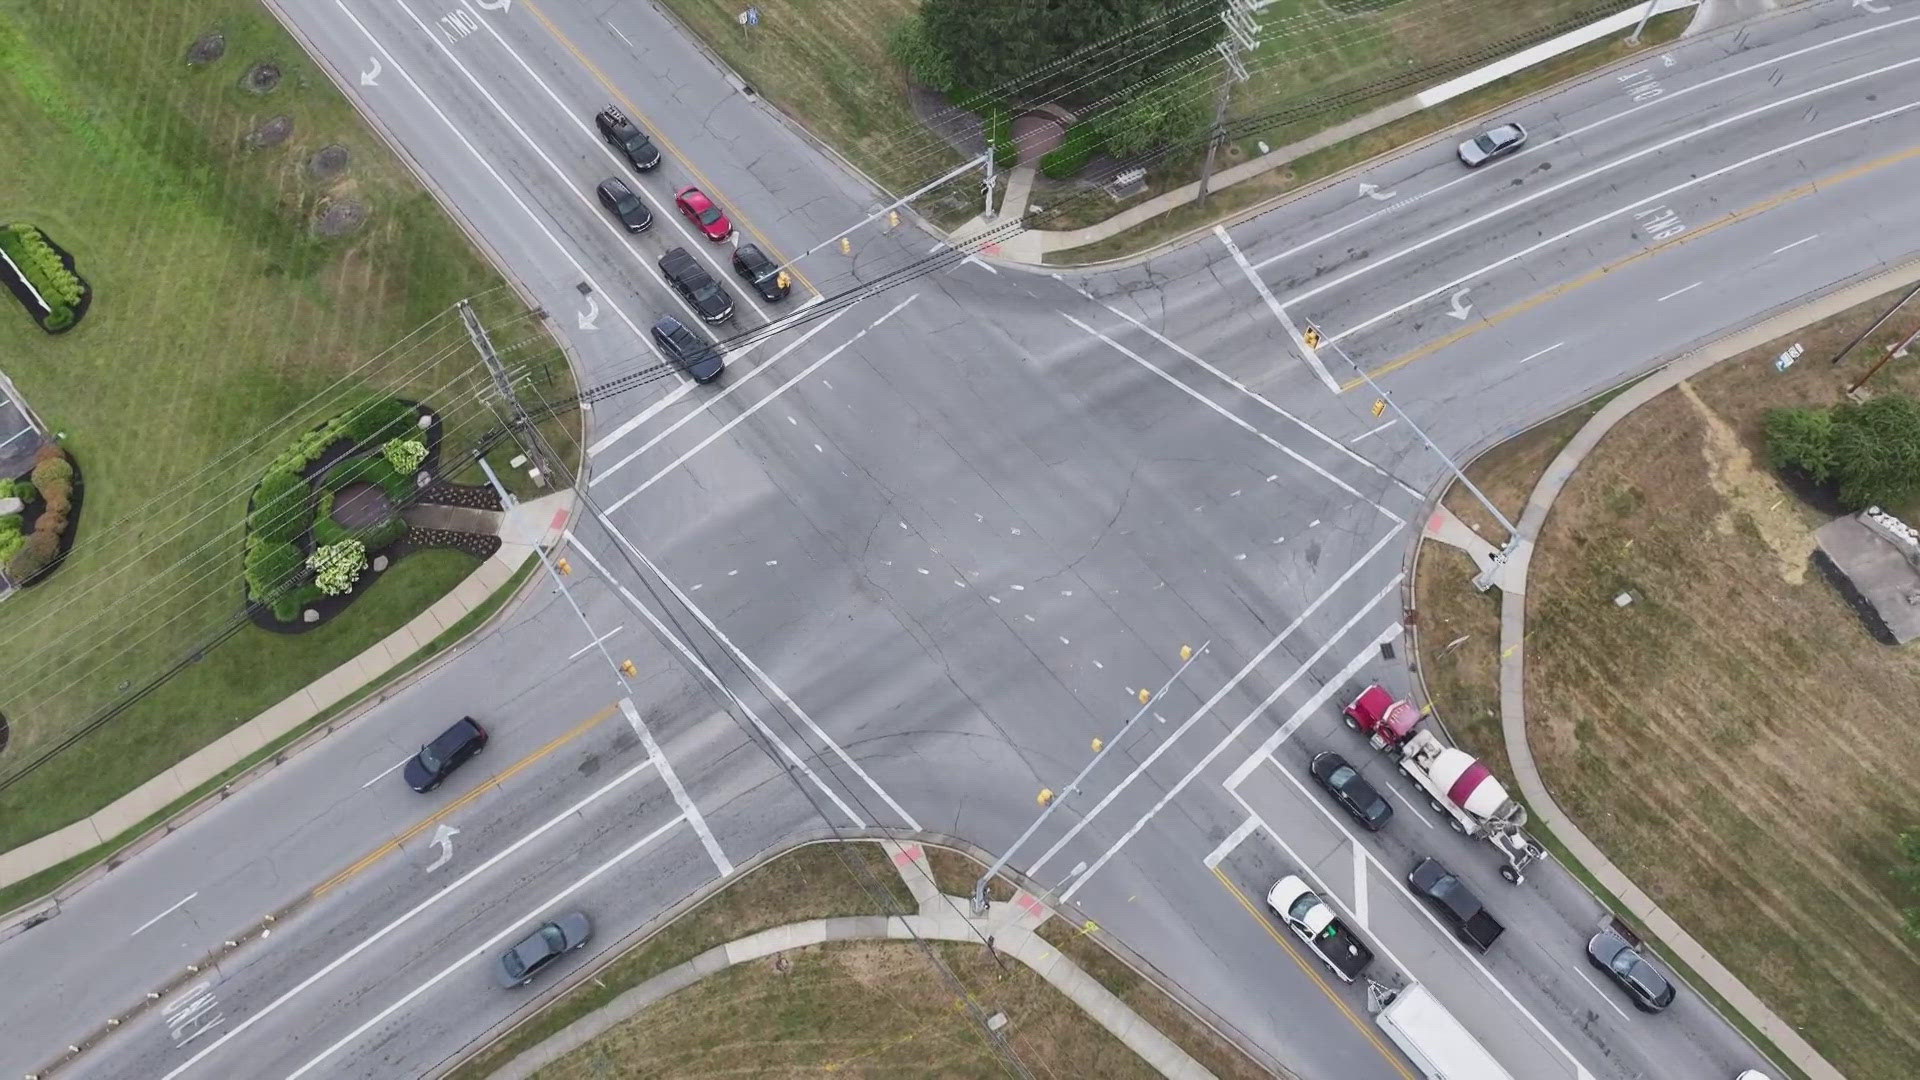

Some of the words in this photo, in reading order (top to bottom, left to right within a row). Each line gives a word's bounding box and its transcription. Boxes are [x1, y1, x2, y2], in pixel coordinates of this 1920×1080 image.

[435, 9, 478, 44] ONLY
[1633, 205, 1686, 240] ONLY
[161, 981, 226, 1048] ONLY
